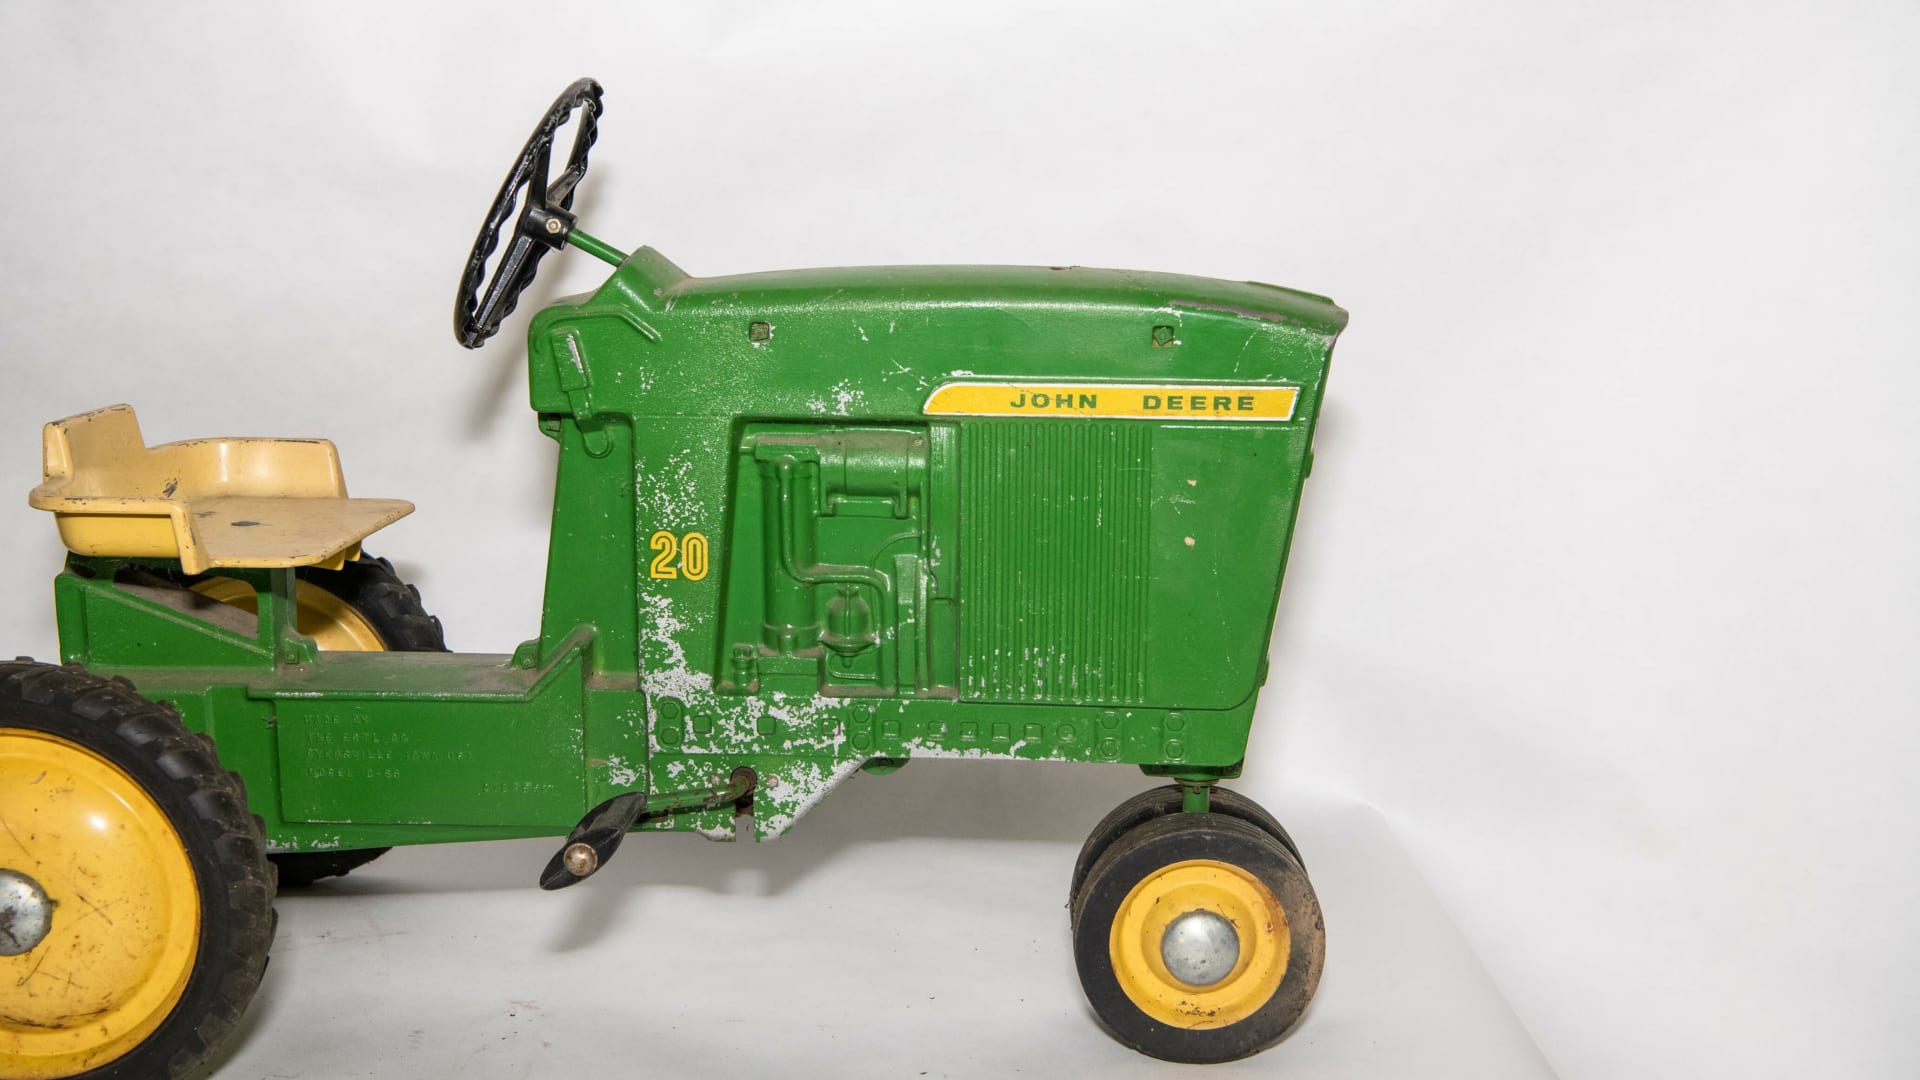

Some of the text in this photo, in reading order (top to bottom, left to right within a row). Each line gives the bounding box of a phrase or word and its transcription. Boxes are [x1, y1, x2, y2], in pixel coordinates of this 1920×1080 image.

[1010, 394, 1255, 411] JOHN DEERE
[650, 530, 708, 581] 20
